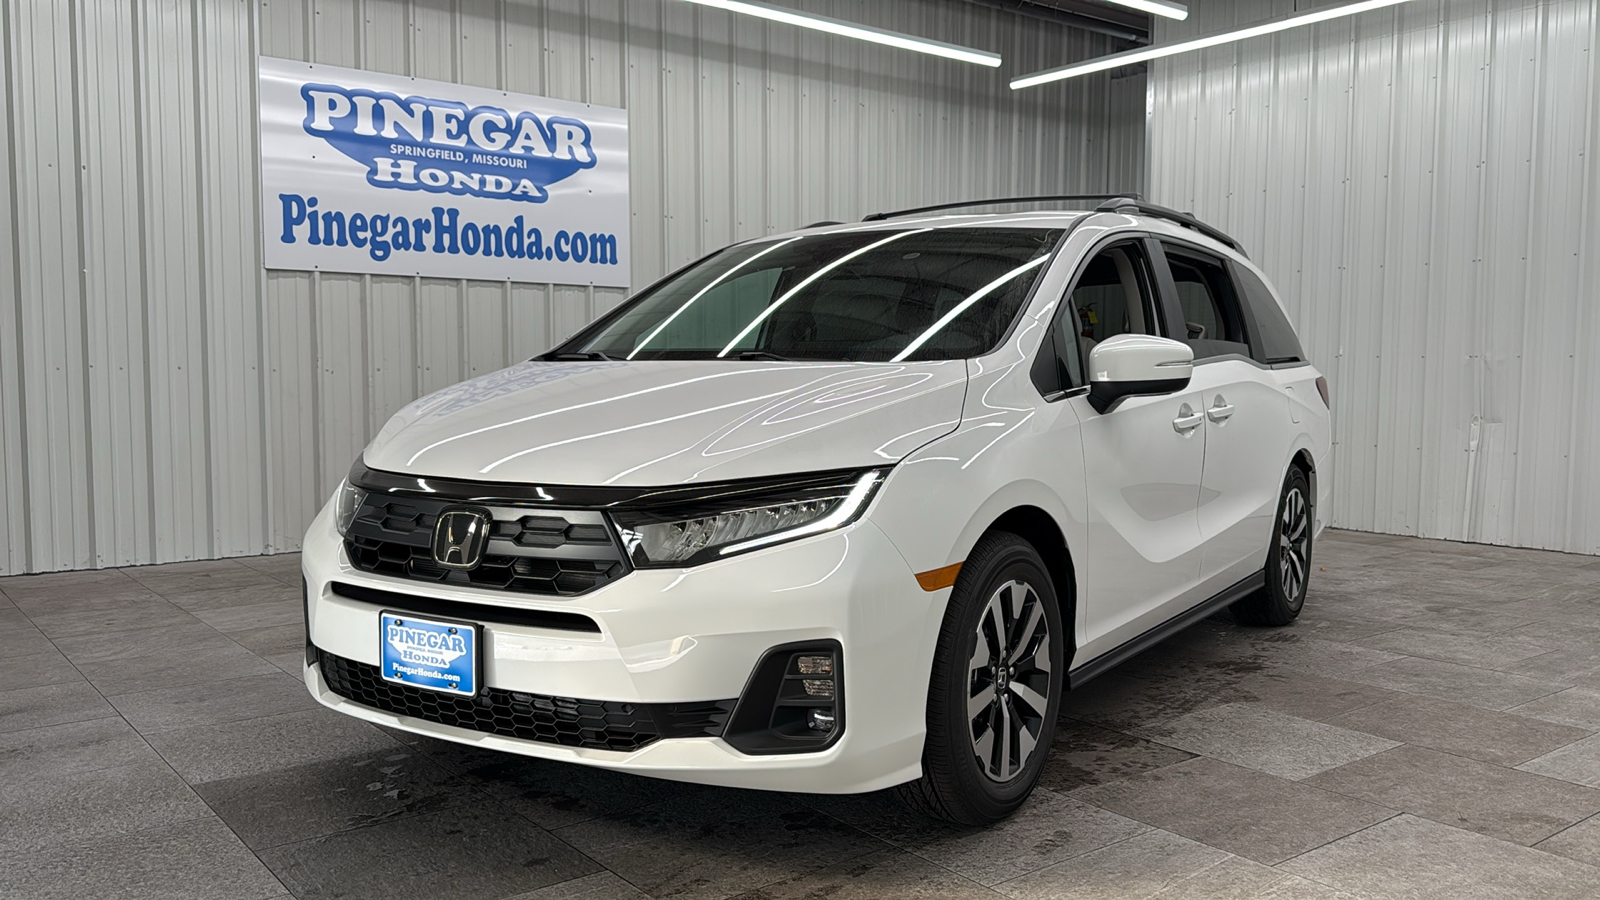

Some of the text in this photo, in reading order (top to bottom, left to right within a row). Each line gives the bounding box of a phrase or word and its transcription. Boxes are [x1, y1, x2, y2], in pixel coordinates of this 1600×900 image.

[306, 89, 592, 164] PINEGAR
[390, 143, 527, 169] SPRINGFIELD, MISSOURI
[372, 156, 544, 198] HONDA
[278, 193, 619, 266] PinegarHonda.com
[389, 627, 465, 653] PINEGAR
[402, 649, 448, 666] HONDA
[392, 662, 461, 682] PinegarHonda.com
